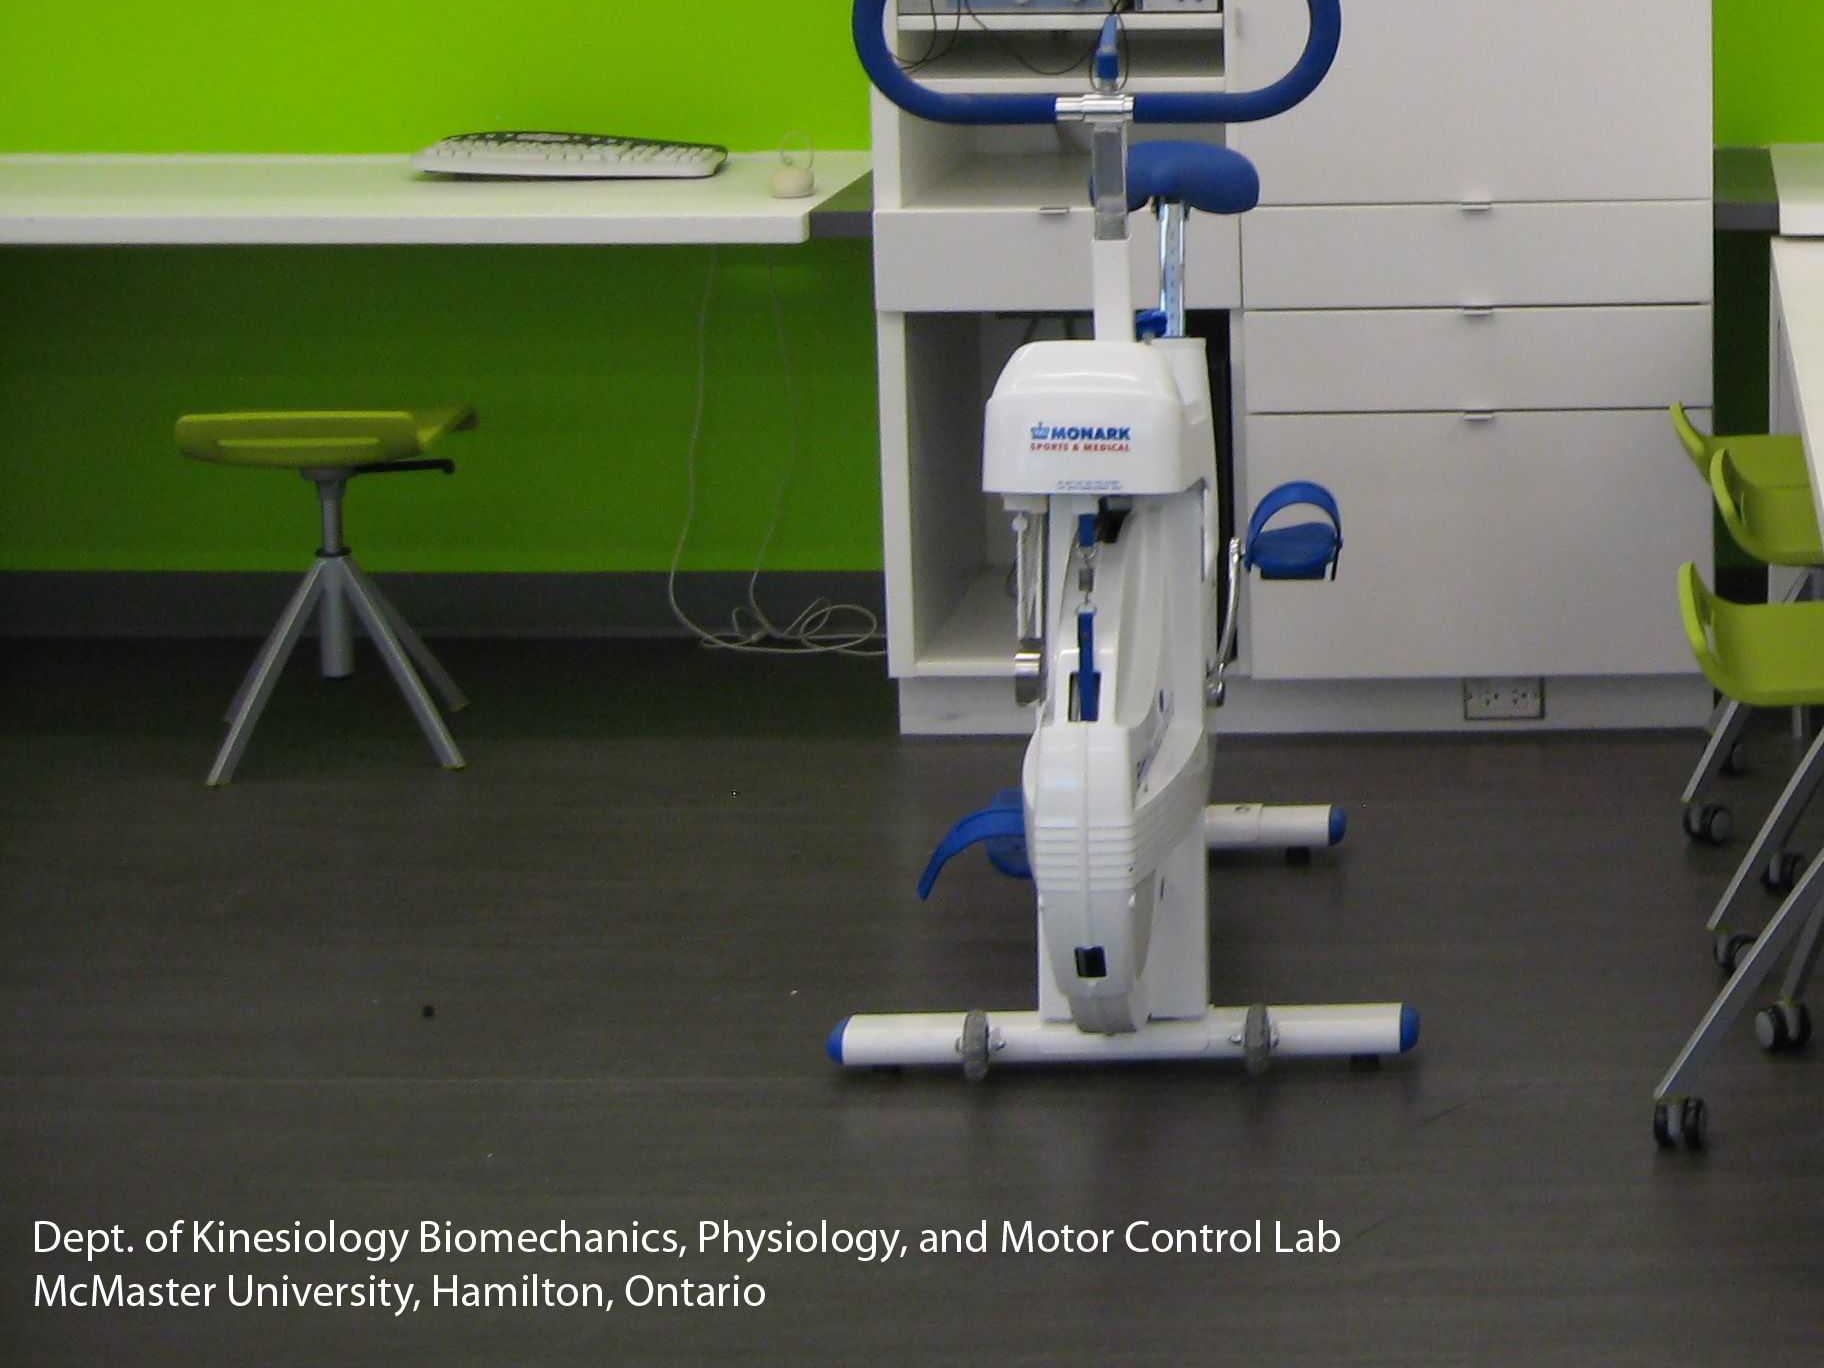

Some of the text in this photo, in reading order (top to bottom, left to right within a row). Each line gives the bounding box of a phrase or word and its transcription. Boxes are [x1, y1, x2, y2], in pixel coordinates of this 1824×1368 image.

[1051, 426, 1132, 441] MONARK
[1030, 442, 1069, 452] SPORTS
[1083, 442, 1131, 452] MEDICAL
